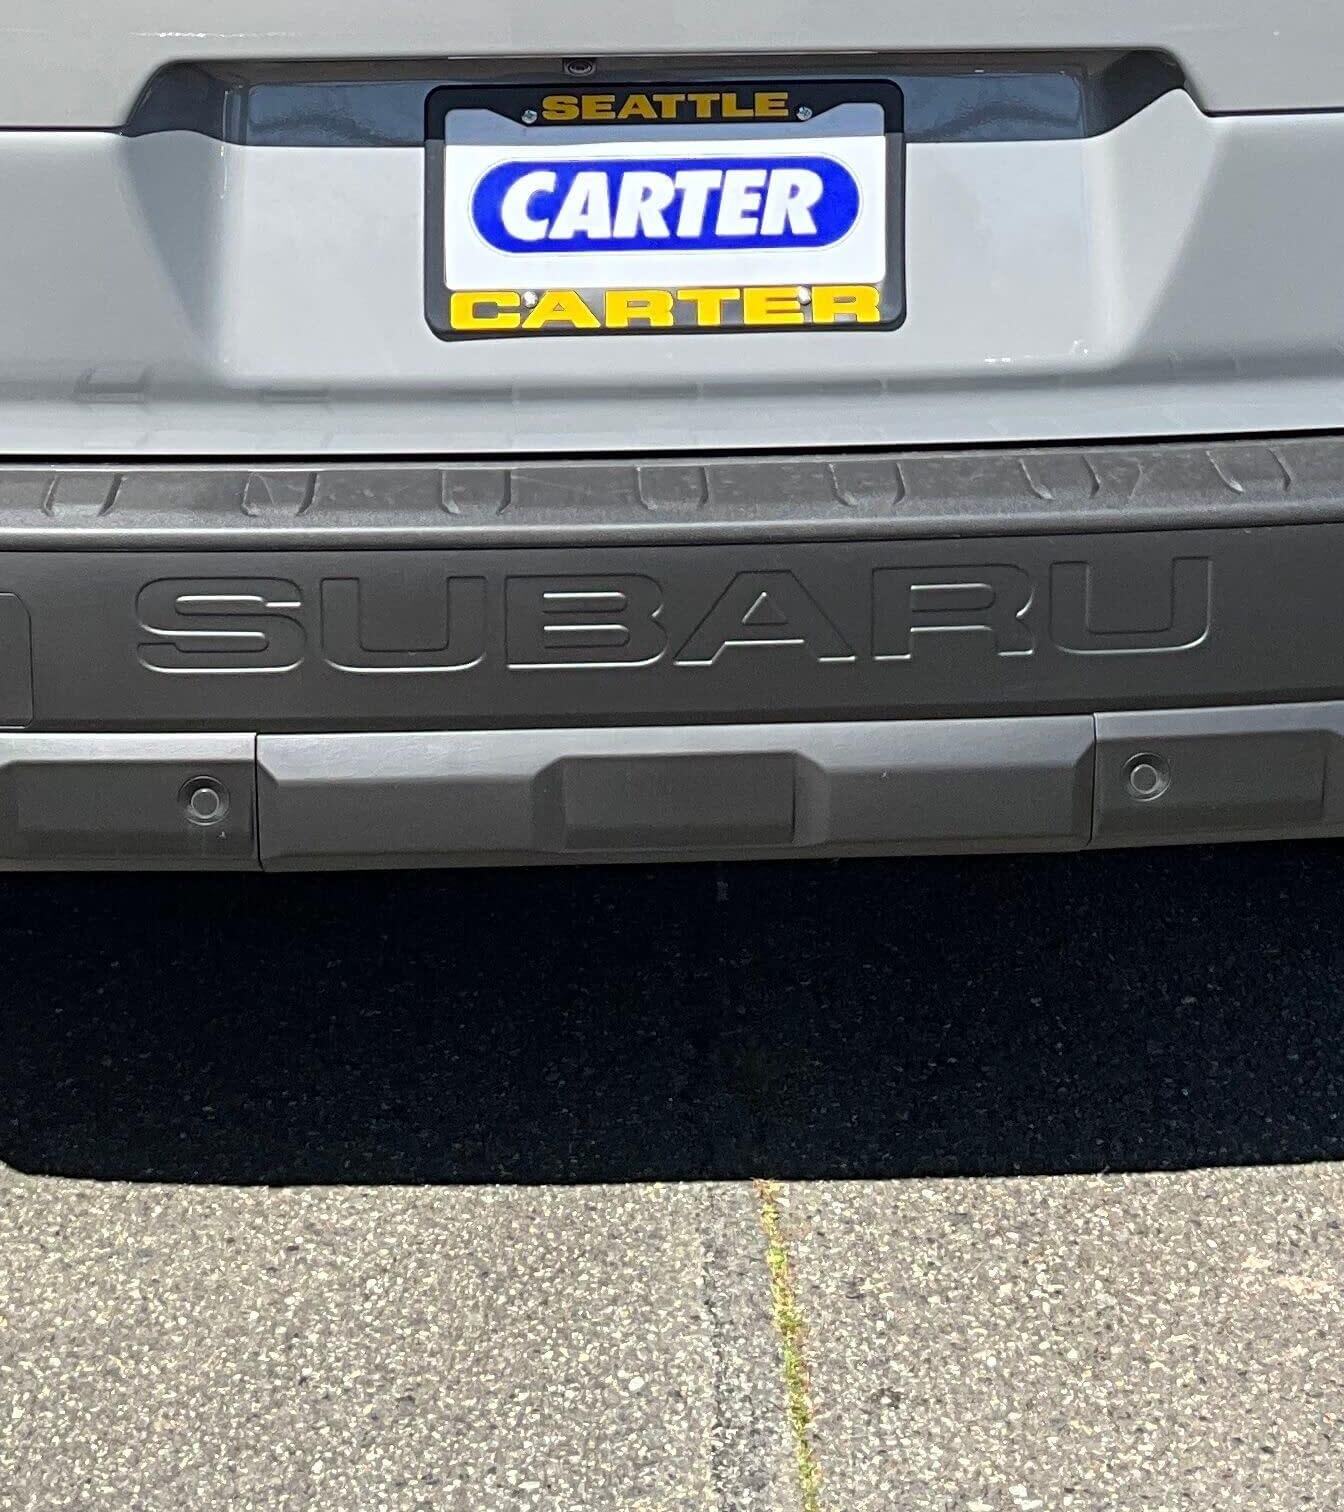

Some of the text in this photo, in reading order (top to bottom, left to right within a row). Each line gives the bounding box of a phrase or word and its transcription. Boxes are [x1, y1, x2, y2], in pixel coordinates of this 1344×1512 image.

[541, 92, 790, 121] SEATTLE
[500, 168, 824, 242] CARTER
[450, 285, 881, 330] CARTER
[134, 556, 1212, 674] SUBARU
